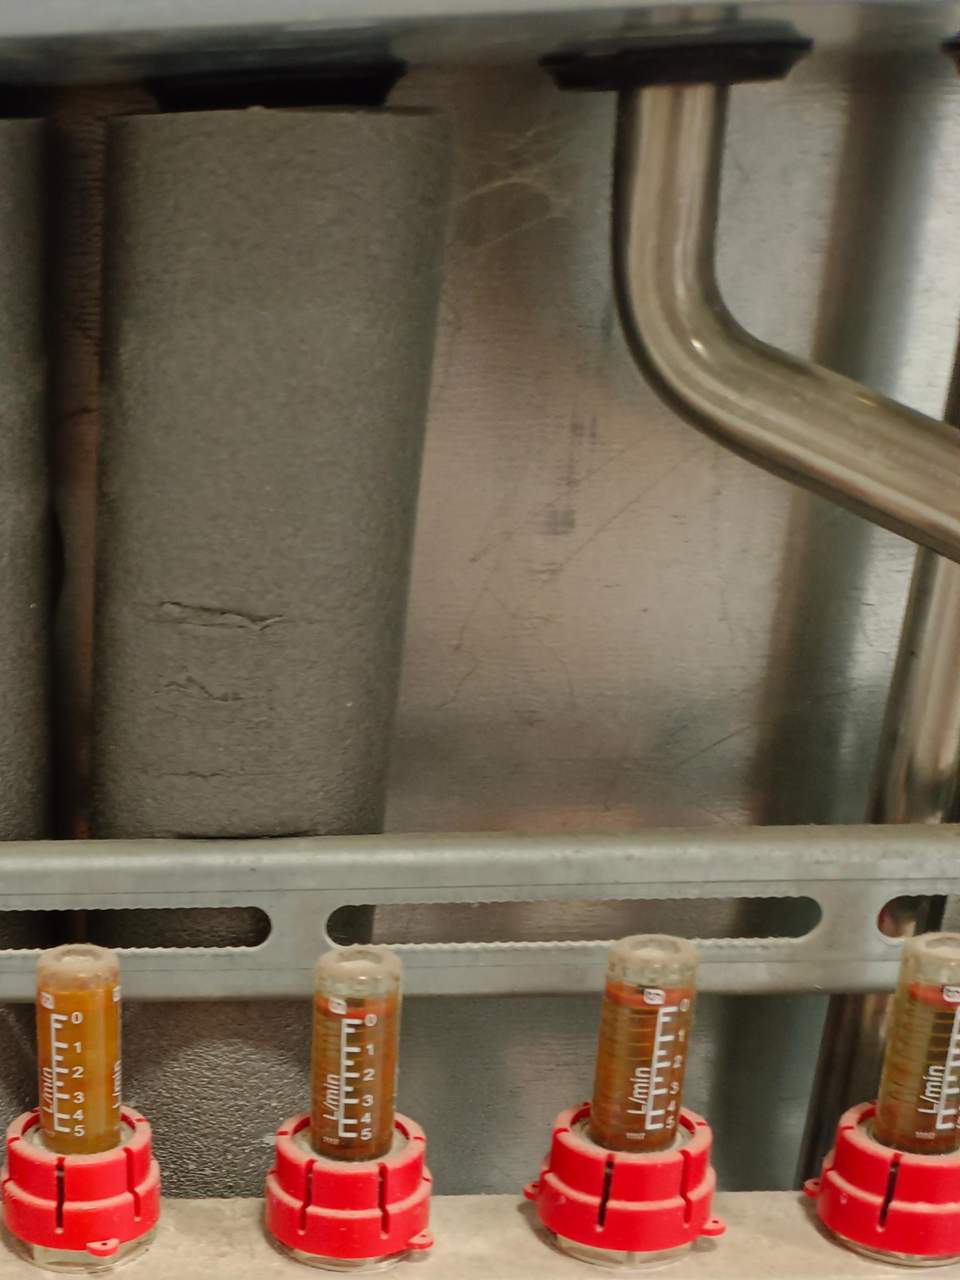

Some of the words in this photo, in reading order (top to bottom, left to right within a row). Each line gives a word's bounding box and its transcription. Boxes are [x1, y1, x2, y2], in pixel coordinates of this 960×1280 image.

[679, 998, 690, 1012] 0
[71, 1011, 83, 1025] 0
[364, 1013, 377, 1027] 0
[678, 1029, 685, 1042] 1
[73, 1041, 82, 1053] 1
[366, 1044, 375, 1056] 1
[673, 1055, 683, 1068] 2
[71, 1066, 84, 1079] 2
[363, 1068, 375, 1082] 2
[627, 1067, 651, 1114] L/min
[669, 1081, 680, 1095] 3
[917, 1065, 945, 1113] L/min
[73, 1091, 85, 1104] 3
[322, 1073, 340, 1121] L/min
[362, 1094, 374, 1107] 3
[666, 1100, 676, 1112] 4
[72, 1109, 84, 1121] 4
[360, 1112, 372, 1124] 4
[665, 1115, 675, 1129] 5
[74, 1124, 85, 1137] 5
[360, 1127, 372, 1140] 5
